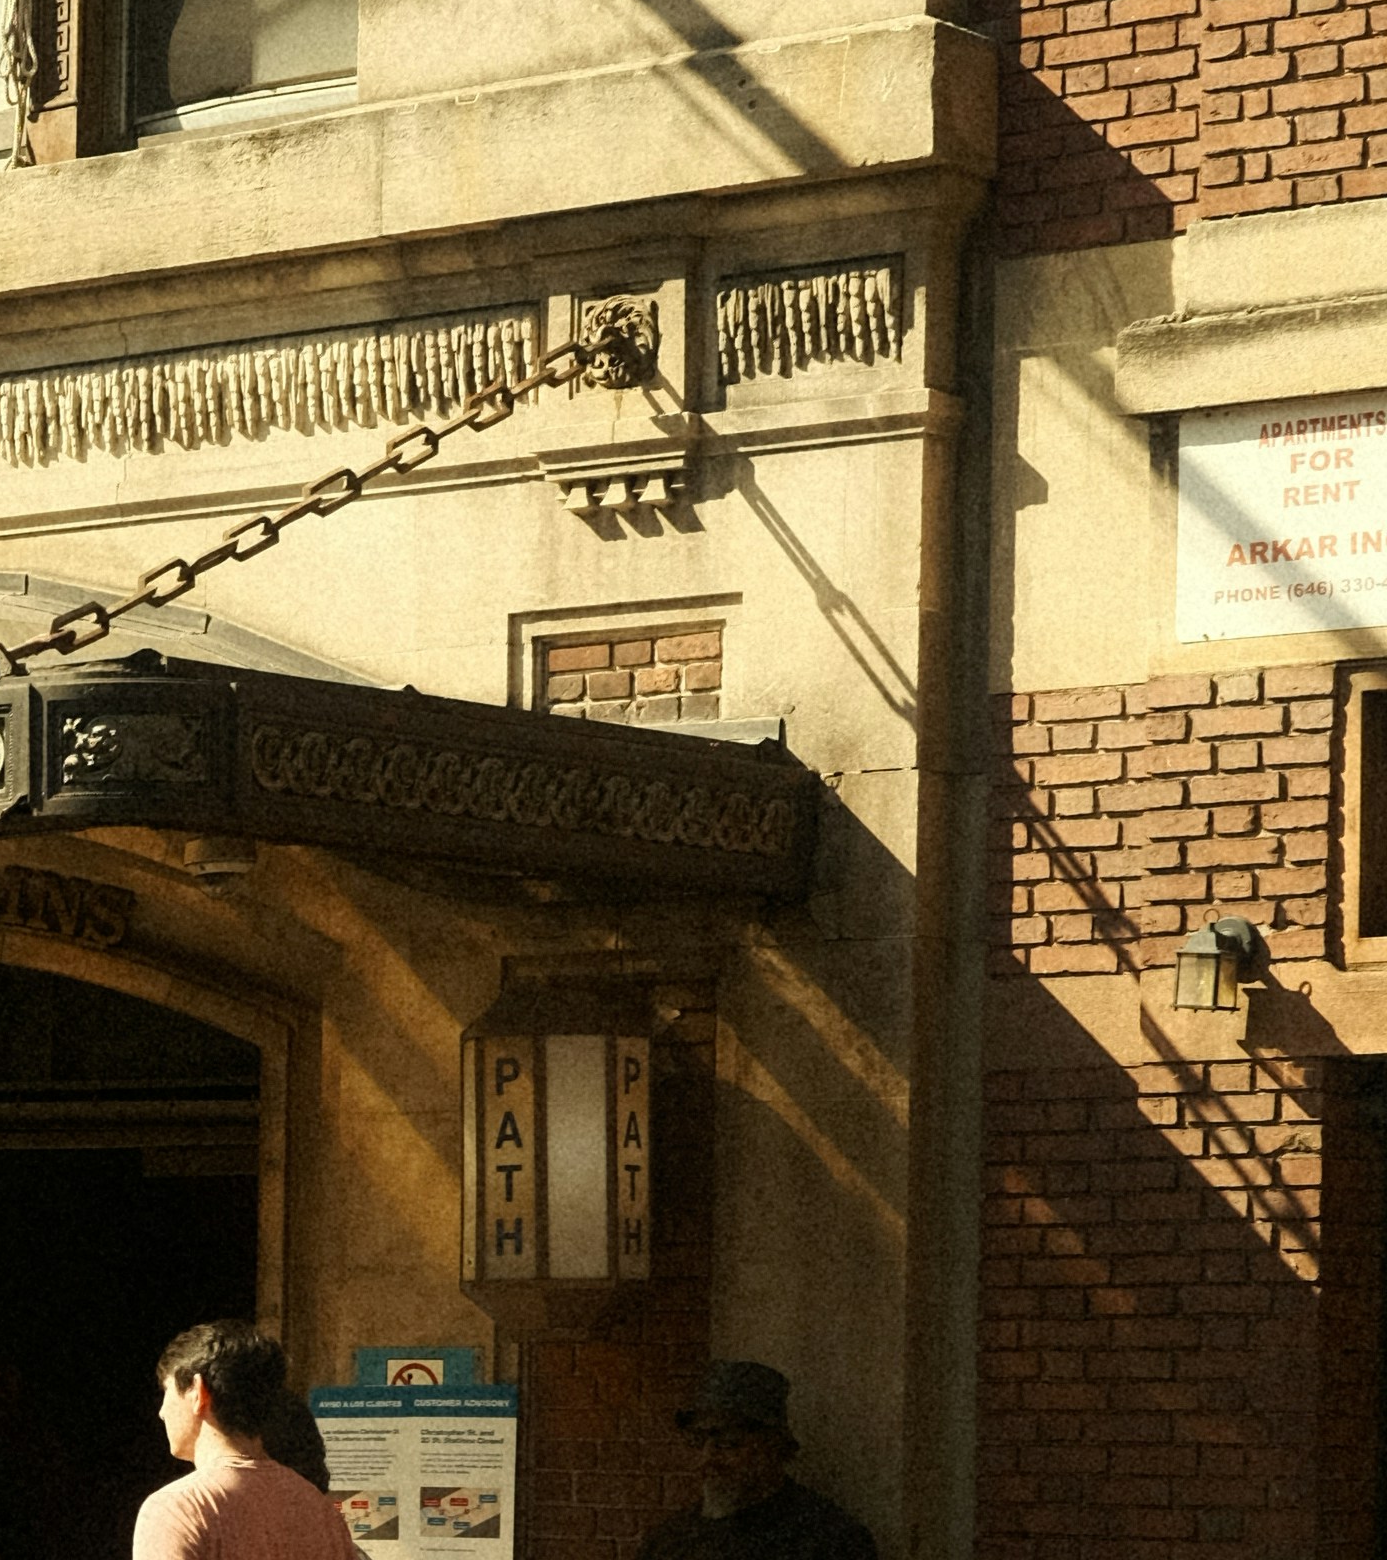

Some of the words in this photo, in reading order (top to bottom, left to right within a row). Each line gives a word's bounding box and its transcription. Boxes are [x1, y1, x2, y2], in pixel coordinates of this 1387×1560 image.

[1259, 410, 1387, 449] APARTMENTS
[1290, 448, 1355, 474] FOR
[1283, 480, 1361, 508] RENT
[1226, 534, 1338, 567] ARKAR
[1350, 530, 1387, 556] IN
[1214, 585, 1280, 606] PHONE
[1287, 580, 1334, 601] (646)
[494, 1056, 523, 1256] PATH
[624, 1056, 643, 1256] PATH
